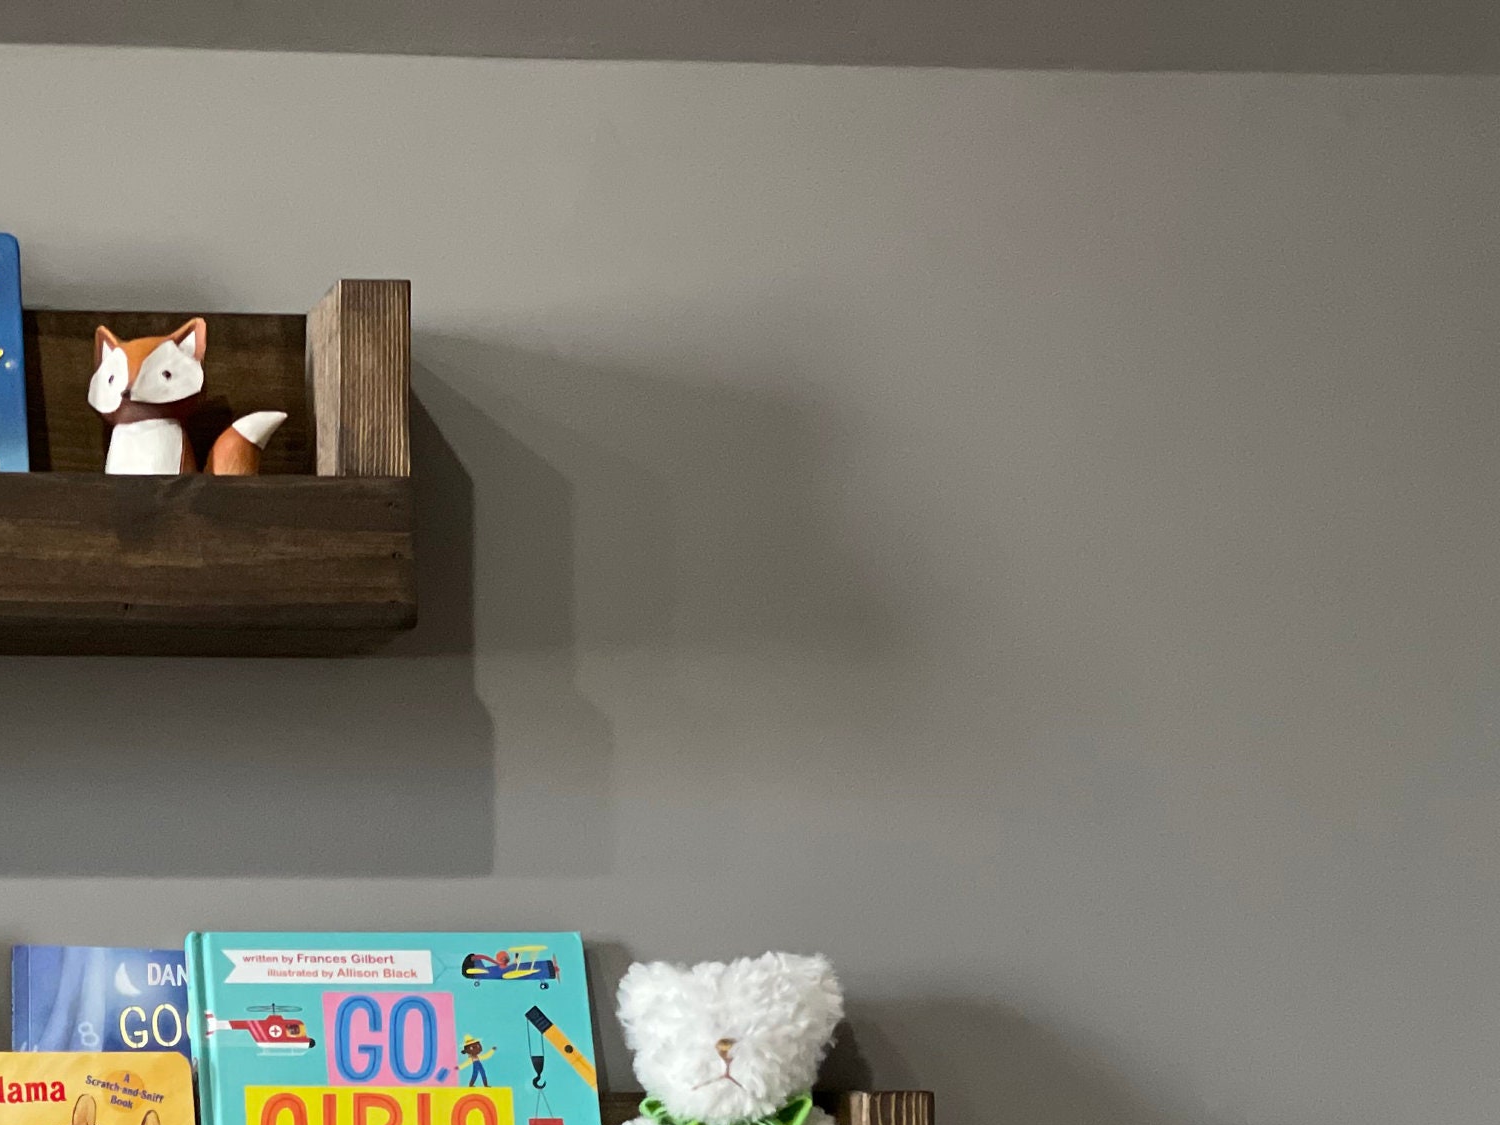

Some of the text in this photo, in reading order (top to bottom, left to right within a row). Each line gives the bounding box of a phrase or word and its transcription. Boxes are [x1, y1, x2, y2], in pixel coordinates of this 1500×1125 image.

[242, 953, 395, 964] written by Frances Gilbert
[267, 967, 418, 979] illustrated by Allison Black
[119, 1003, 192, 1049] GO
[123, 1073, 131, 1083] A
[110, 1094, 134, 1109] Book
